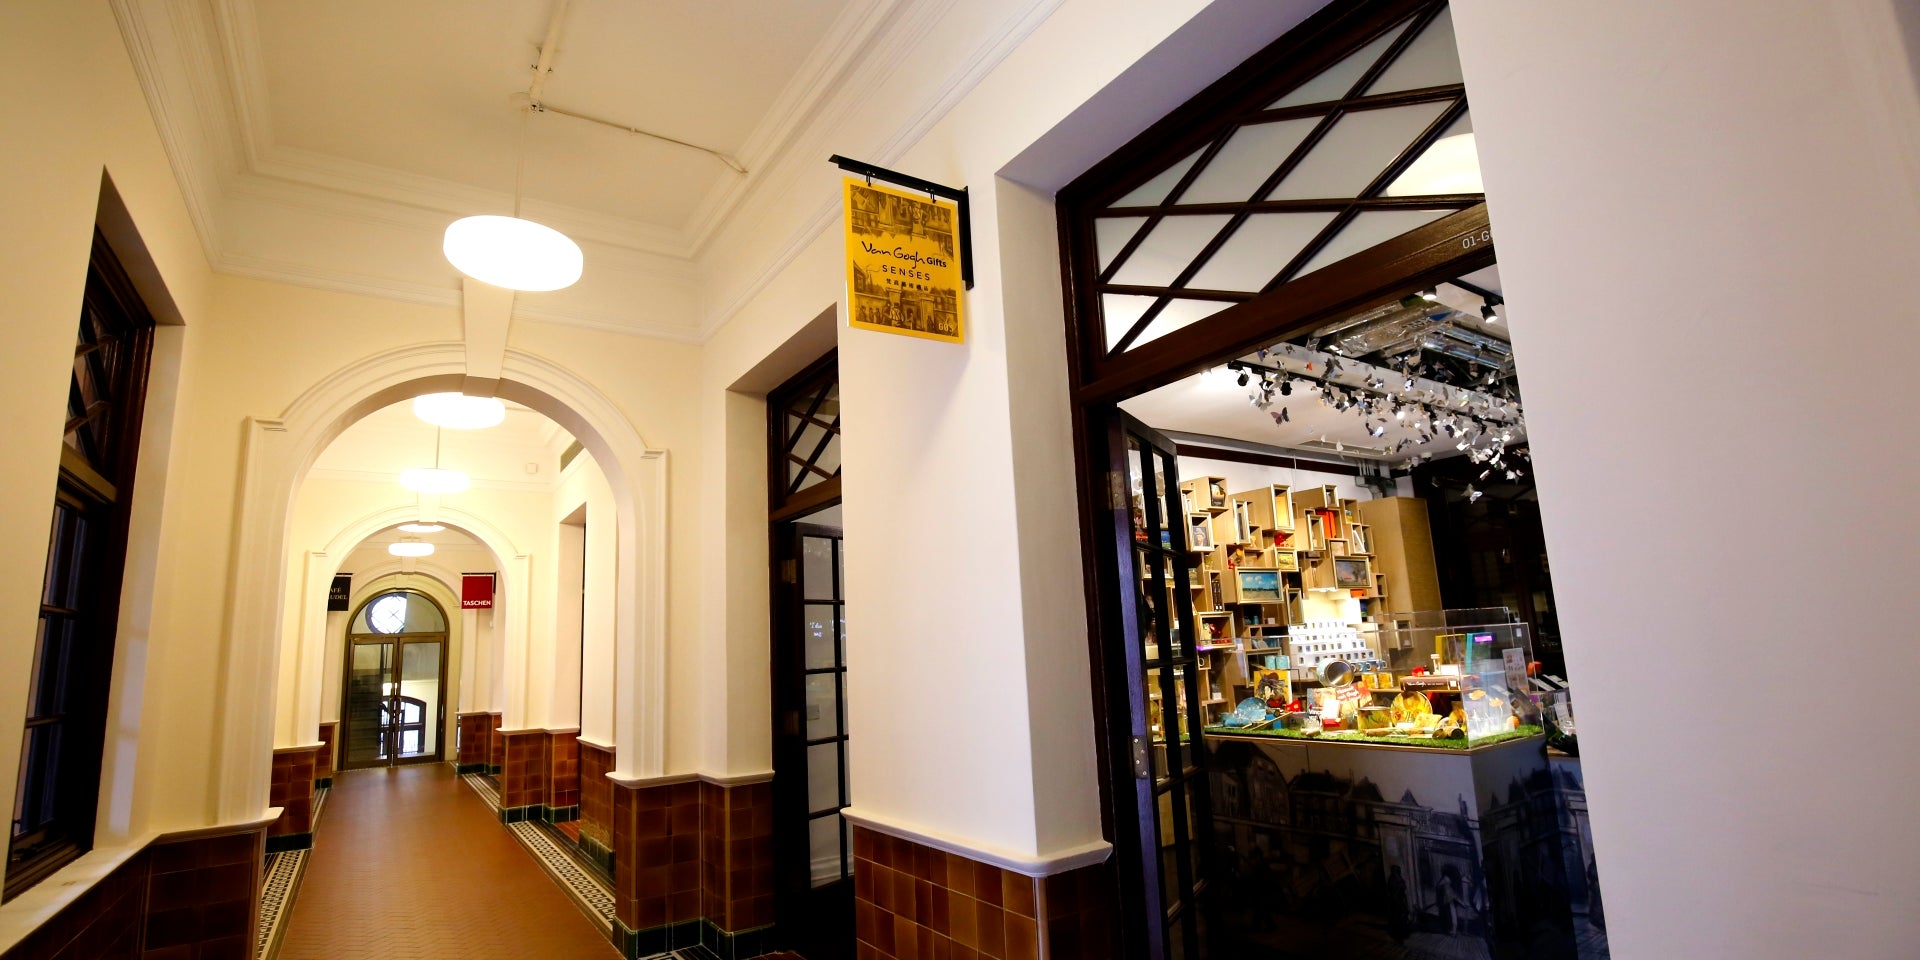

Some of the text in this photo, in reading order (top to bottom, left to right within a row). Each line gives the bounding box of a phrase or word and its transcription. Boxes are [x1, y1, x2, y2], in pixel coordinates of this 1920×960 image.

[1462, 230, 1490, 249] 01-G
[861, 240, 947, 269] Van Gogh Gifts
[882, 264, 930, 281] SENSES
